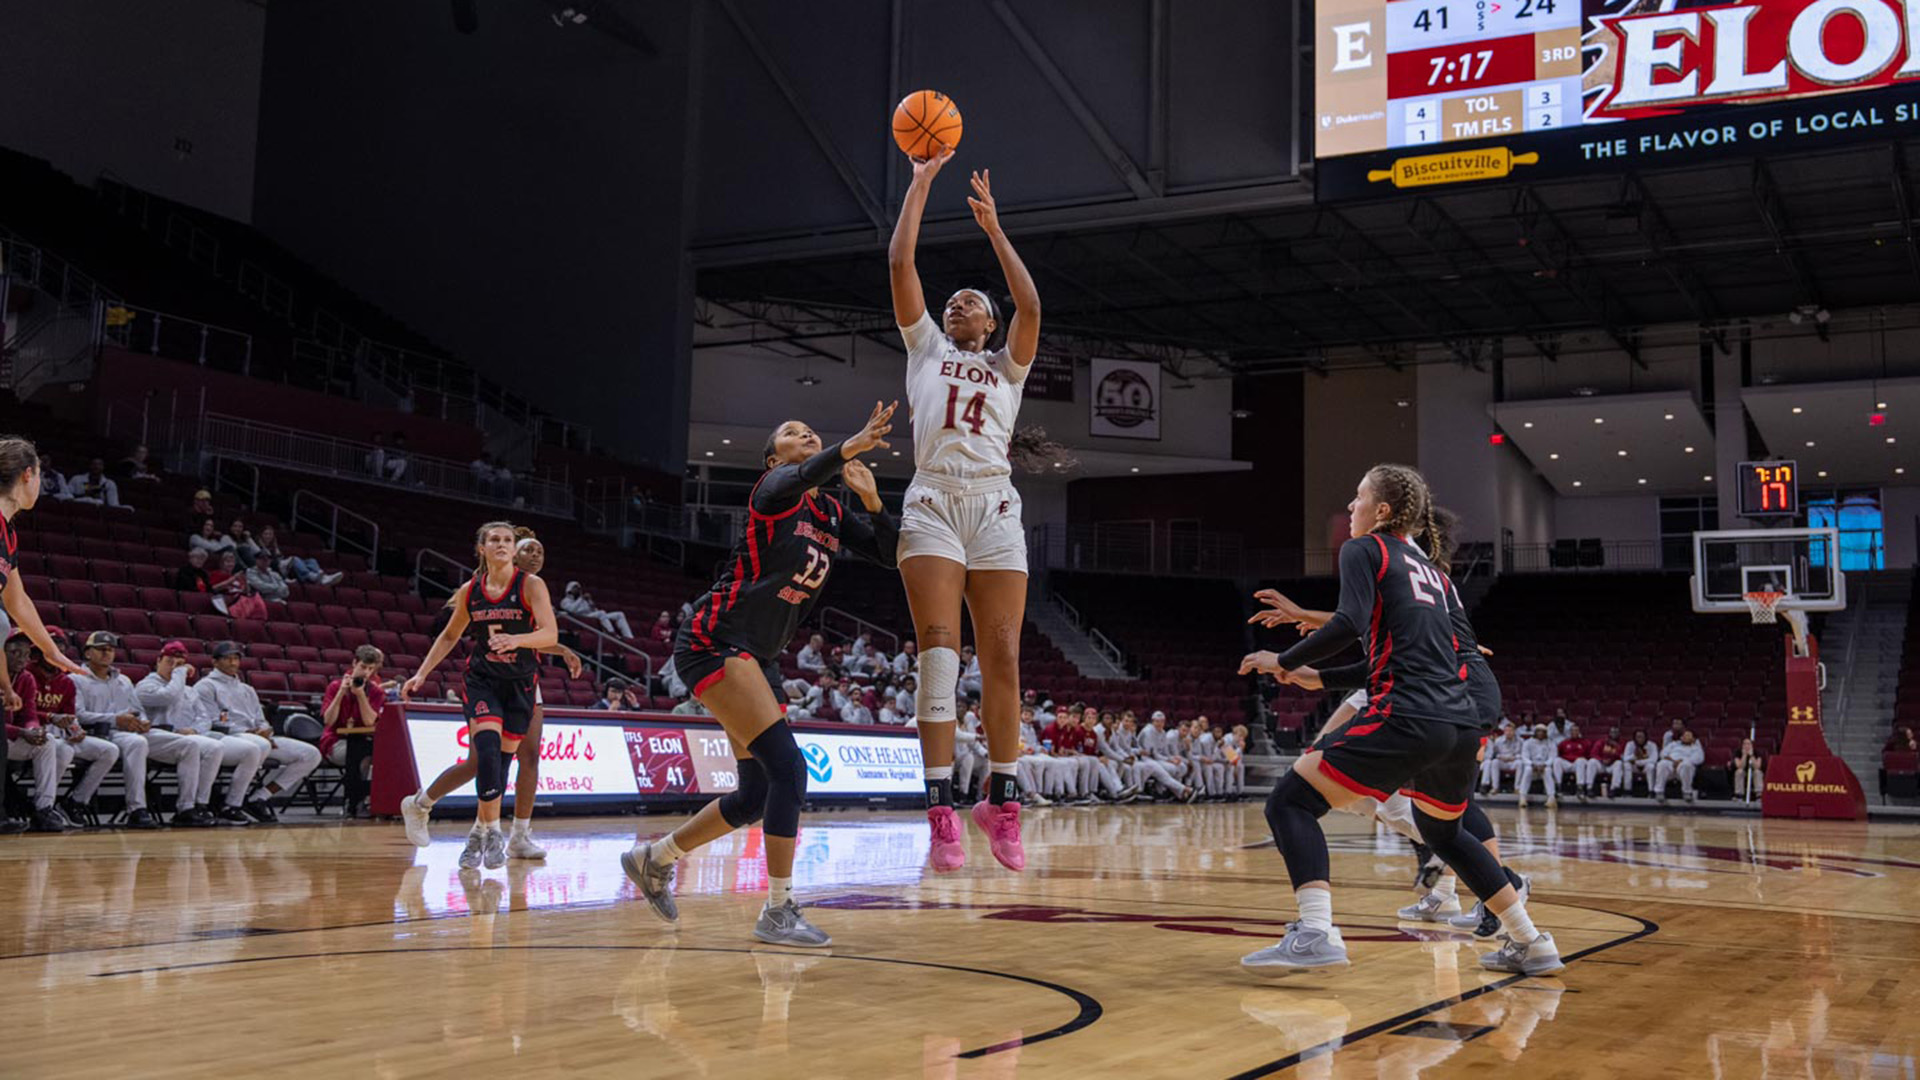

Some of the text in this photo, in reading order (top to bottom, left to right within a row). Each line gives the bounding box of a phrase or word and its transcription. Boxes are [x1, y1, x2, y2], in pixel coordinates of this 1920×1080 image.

[1413, 5, 1448, 32] 41
[1514, 0, 1556, 19] 24
[1332, 21, 1373, 72] E
[1541, 47, 1577, 64] 3RD
[1604, 0, 1920, 108] ELO
[1427, 50, 1494, 86] 7:17
[1464, 97, 1500, 113] TOL
[1541, 91, 1550, 104] 3
[1416, 107, 1426, 119] 4
[1541, 114, 1551, 127] 2
[1419, 130, 1426, 141] 1
[1451, 116, 1513, 138] TM FLS
[1580, 139, 1628, 160] THE
[1639, 126, 1738, 153] FLAVOR
[1748, 119, 1784, 140] OF
[1795, 108, 1884, 134] LOCAL
[1402, 152, 1502, 180] Biscuitville
[940, 361, 999, 389] ELON
[942, 384, 987, 436] 14
[1755, 466, 1792, 482] 7:17
[1761, 483, 1787, 509] 17
[792, 545, 830, 589] 33
[1403, 553, 1450, 614] 24
[37, 690, 64, 704] LON
[624, 731, 644, 743] TFLS
[648, 737, 684, 754] ELON
[634, 744, 642, 758] 1
[699, 738, 730, 757] 7:17
[838, 745, 922, 765] CONE HEALTH
[638, 762, 646, 776] 4
[666, 766, 685, 786] 41
[637, 776, 654, 788] TOL
[710, 770, 738, 789] 3RD
[1766, 782, 1848, 794] FULLER DENTAL
